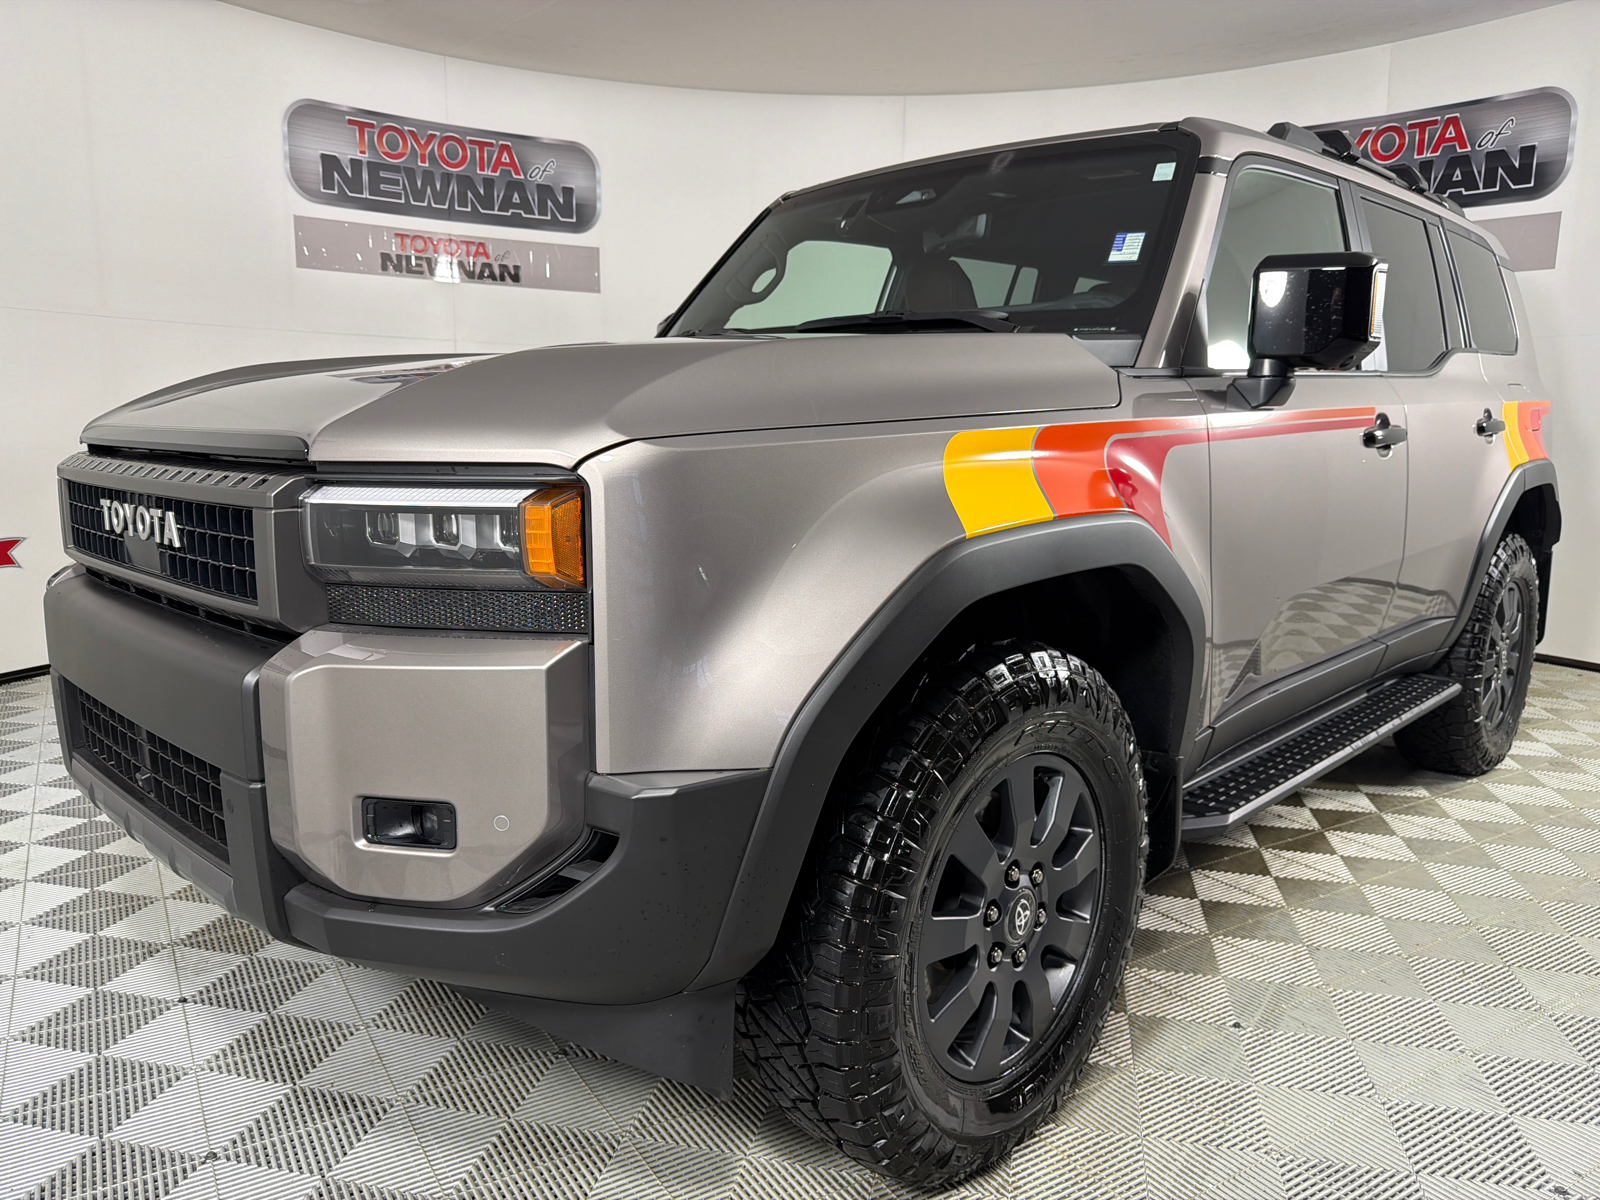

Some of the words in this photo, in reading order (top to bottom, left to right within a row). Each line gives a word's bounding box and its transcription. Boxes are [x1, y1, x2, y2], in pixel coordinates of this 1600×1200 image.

[346, 116, 525, 178] TOYOTA
[528, 159, 556, 181] of
[1476, 117, 1516, 149] of
[319, 153, 576, 222] NEWNAN
[393, 232, 491, 260] TOYOTA
[99, 497, 181, 549] TOYOTA
